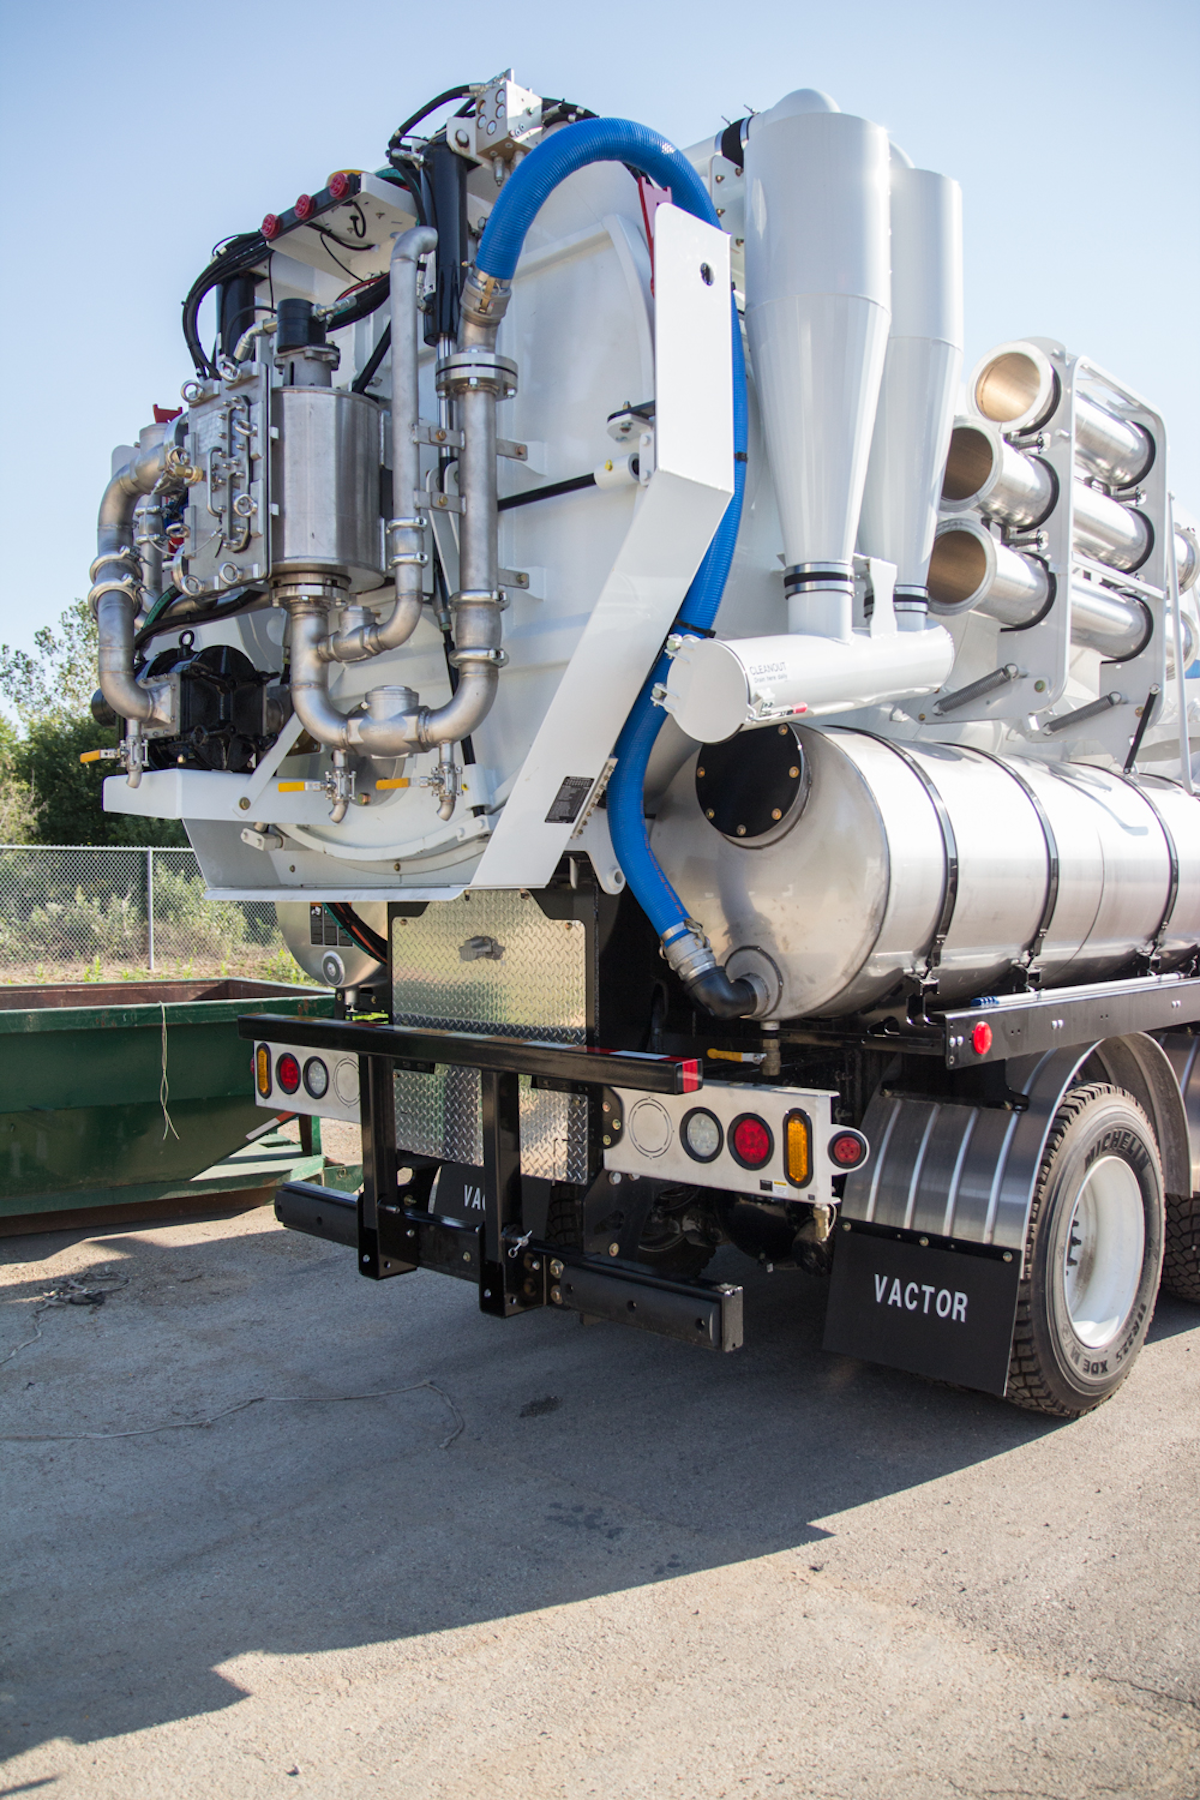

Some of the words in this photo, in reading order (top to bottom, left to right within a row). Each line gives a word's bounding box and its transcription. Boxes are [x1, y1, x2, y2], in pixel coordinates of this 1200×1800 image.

[749, 662, 786, 675] CLEANOUT
[1084, 1130, 1149, 1175] MICHELIN
[875, 1273, 968, 1323] VACTOR
[1083, 1358, 1108, 1375] XDE
